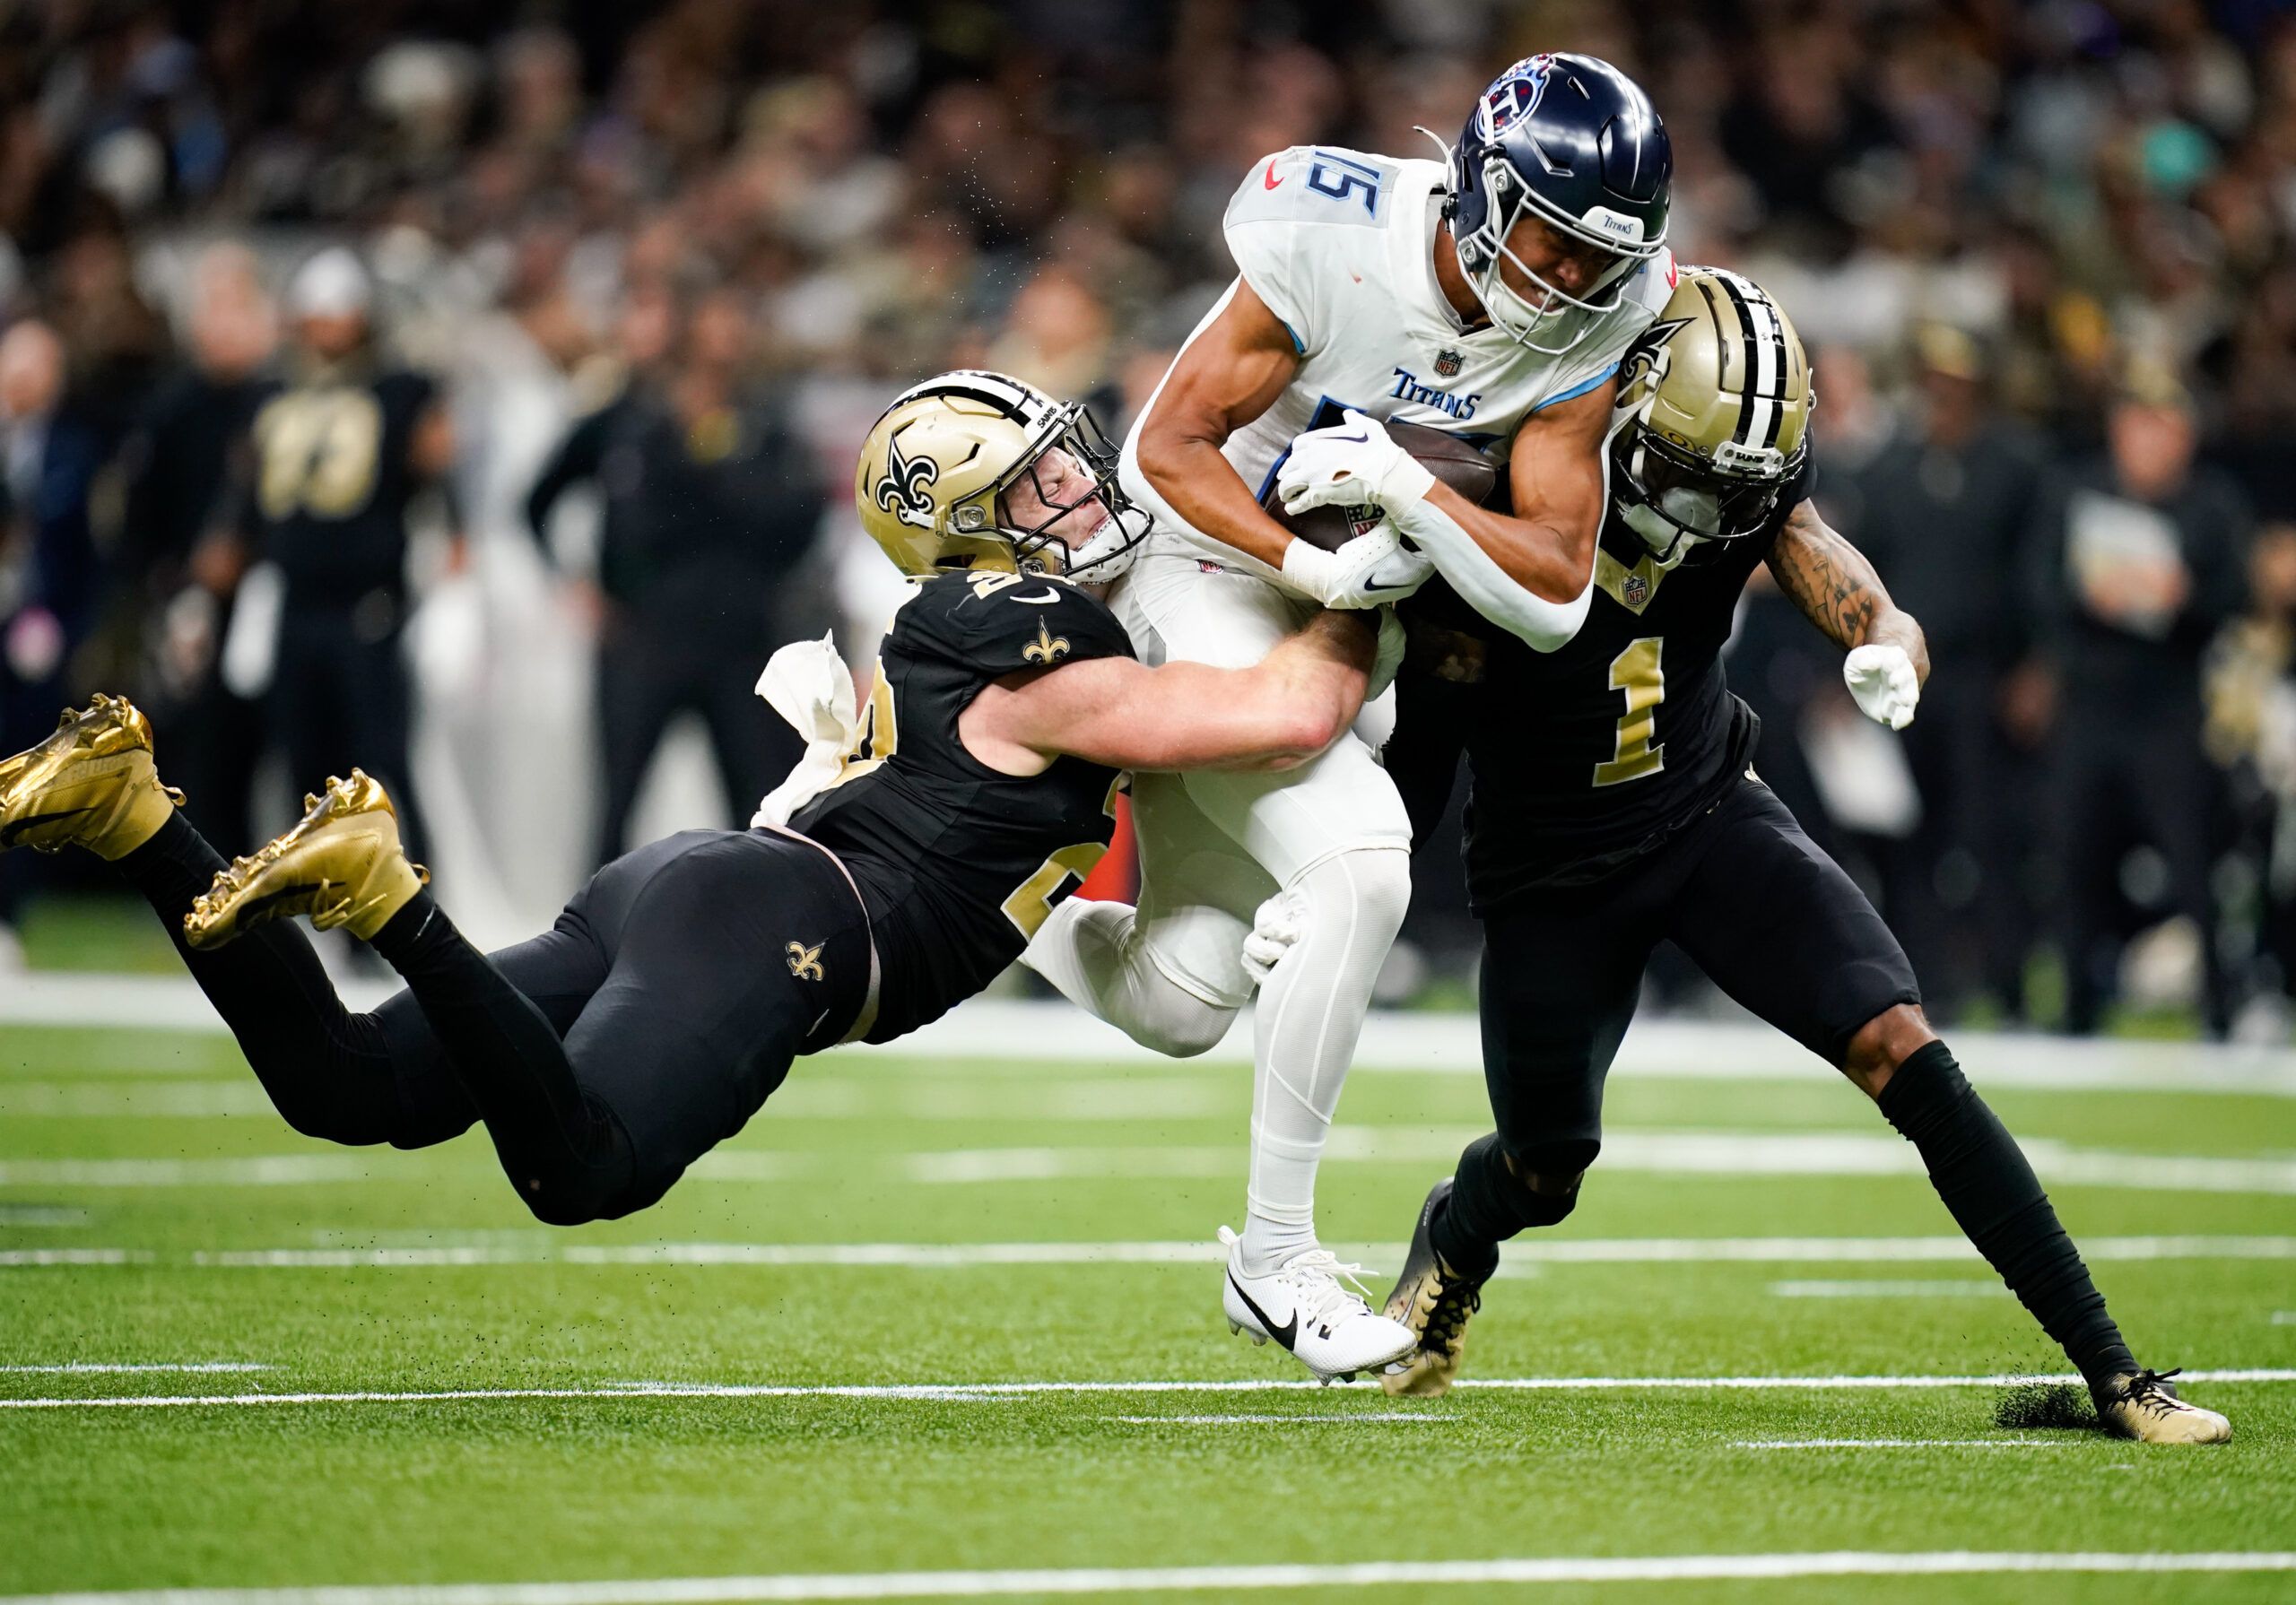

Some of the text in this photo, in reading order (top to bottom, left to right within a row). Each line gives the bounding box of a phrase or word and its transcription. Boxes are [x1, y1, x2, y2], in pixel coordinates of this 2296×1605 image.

[1306, 151, 1382, 221] 15
[1436, 359, 1457, 375] NFL
[1627, 589, 1647, 603] NFL
[1592, 636, 1665, 787] 1
